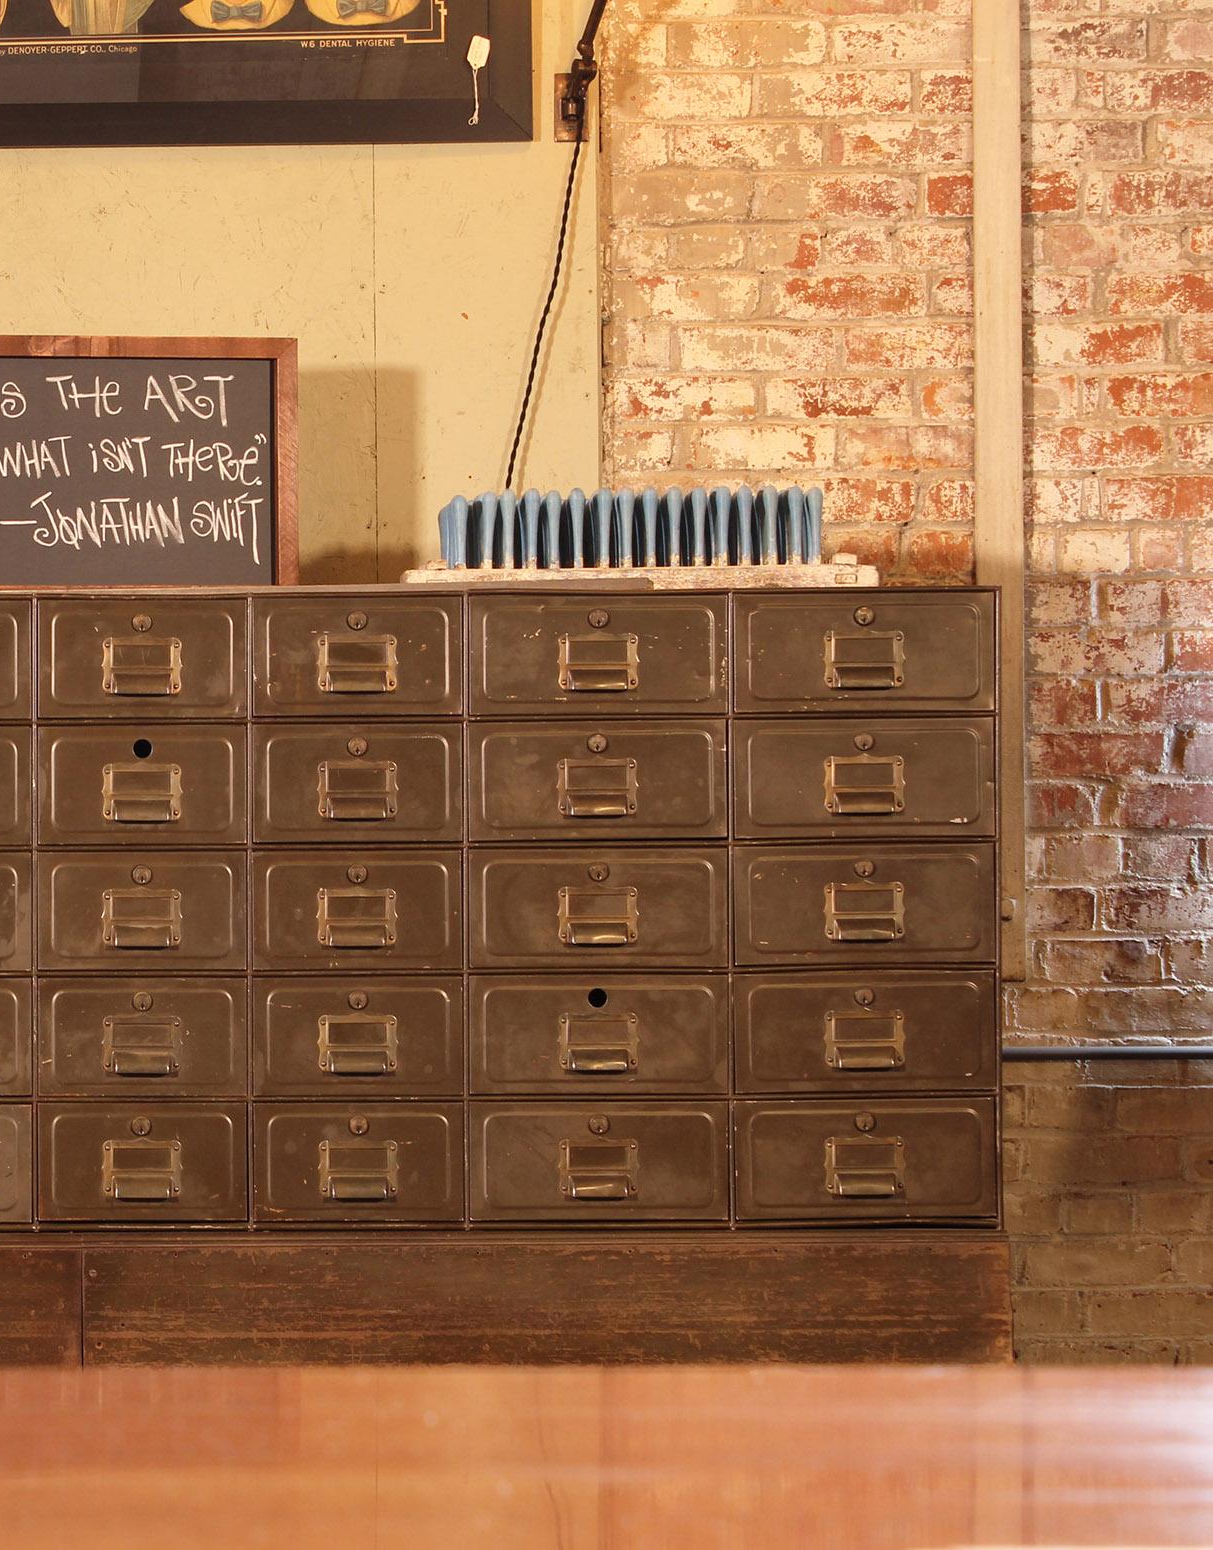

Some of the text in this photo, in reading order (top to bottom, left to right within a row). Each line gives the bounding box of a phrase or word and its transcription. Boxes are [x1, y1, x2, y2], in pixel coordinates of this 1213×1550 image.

[319, 39, 353, 48] DENTAL
[355, 38, 396, 48] HYGIENE
[7, 44, 88, 55] DENOYER-GEPPERT
[108, 44, 138, 54] Chicago
[144, 374, 235, 427] ART
